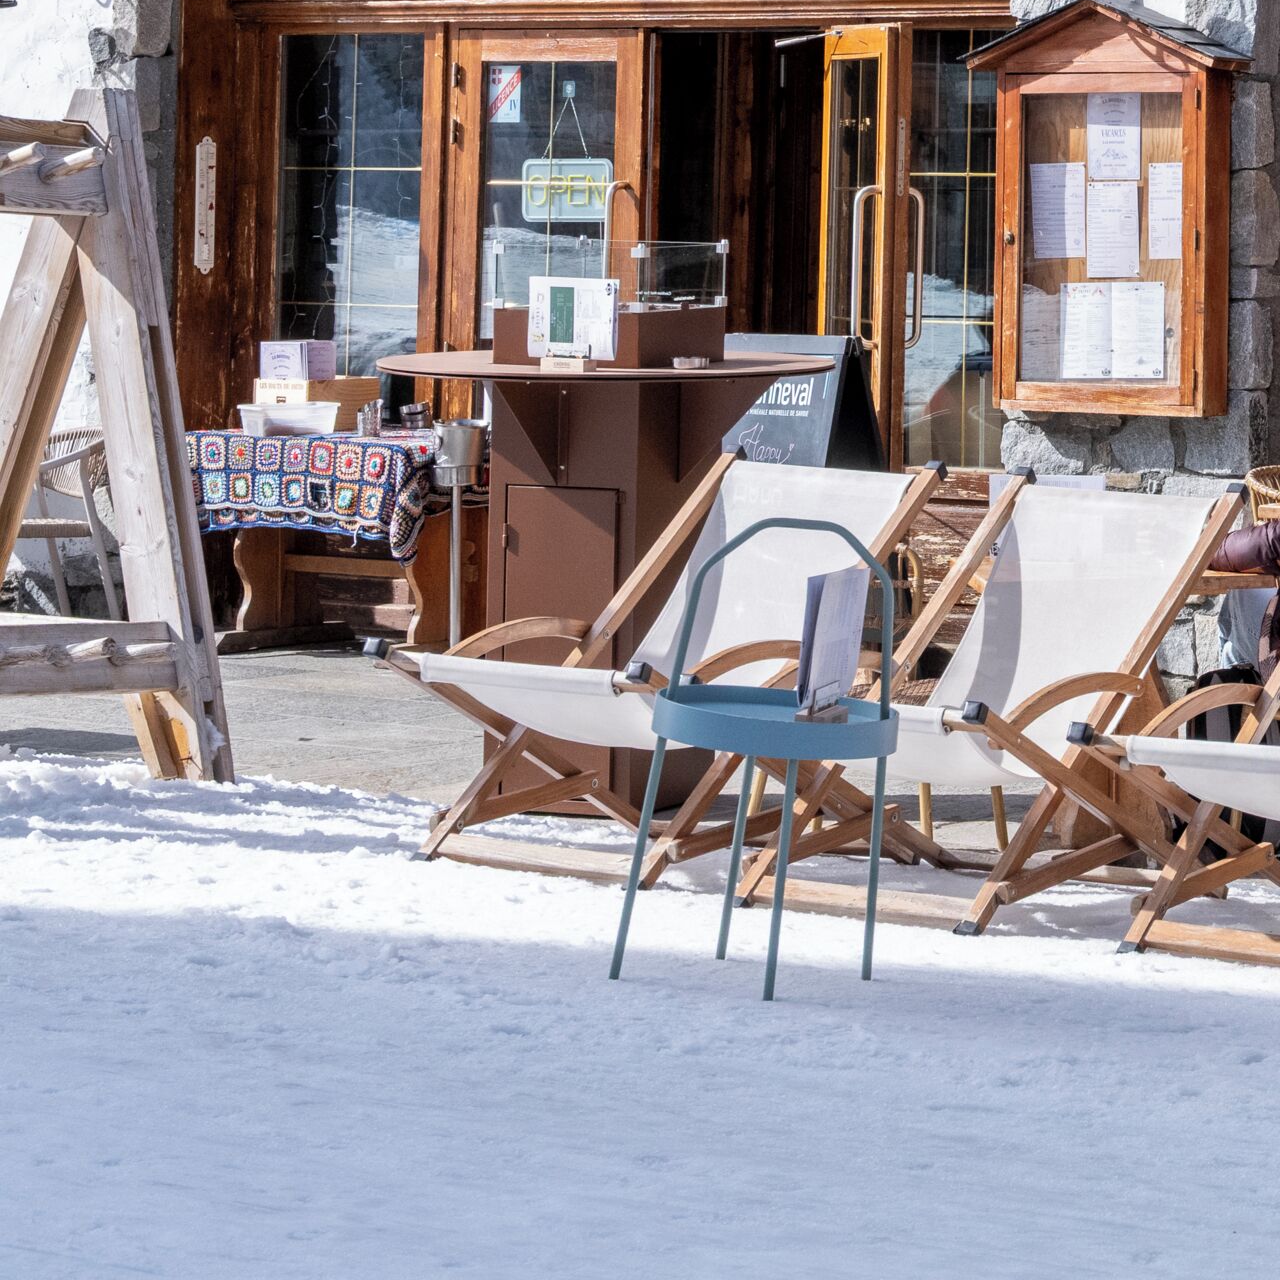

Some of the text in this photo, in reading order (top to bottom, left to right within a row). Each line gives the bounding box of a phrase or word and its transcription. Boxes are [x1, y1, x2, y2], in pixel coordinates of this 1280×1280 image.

[491, 71, 521, 114] LICENCE
[509, 99, 519, 111] IV
[527, 175, 605, 208] OPEN
[749, 407, 768, 416] MINÉRALE
[768, 409, 790, 417] NATURELLE
[795, 410, 809, 418] SAVOIE
[738, 422, 788, 464] Happy
